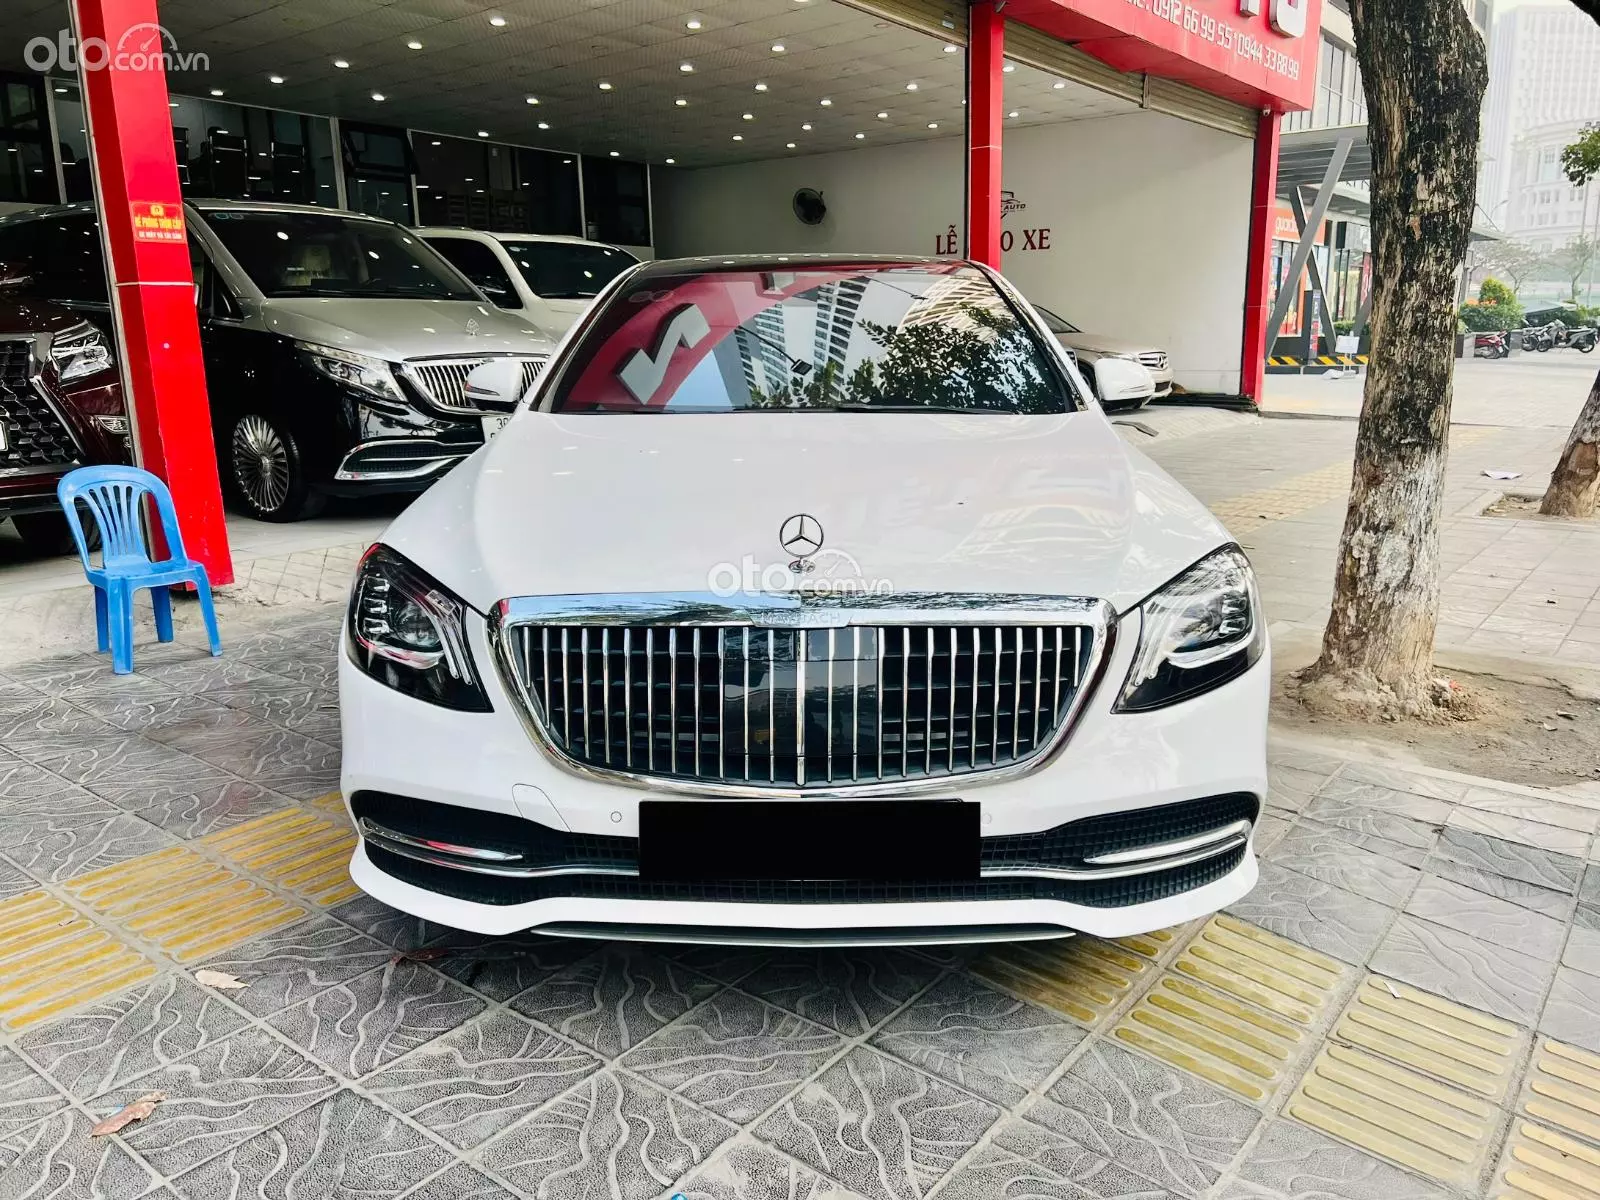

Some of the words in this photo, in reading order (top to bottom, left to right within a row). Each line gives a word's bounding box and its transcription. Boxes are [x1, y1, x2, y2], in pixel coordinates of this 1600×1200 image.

[1183, 5, 1199, 35] 66
[1200, 14, 1215, 42] 99
[935, 224, 958, 255] LỄ
[1022, 229, 1051, 251] XE
